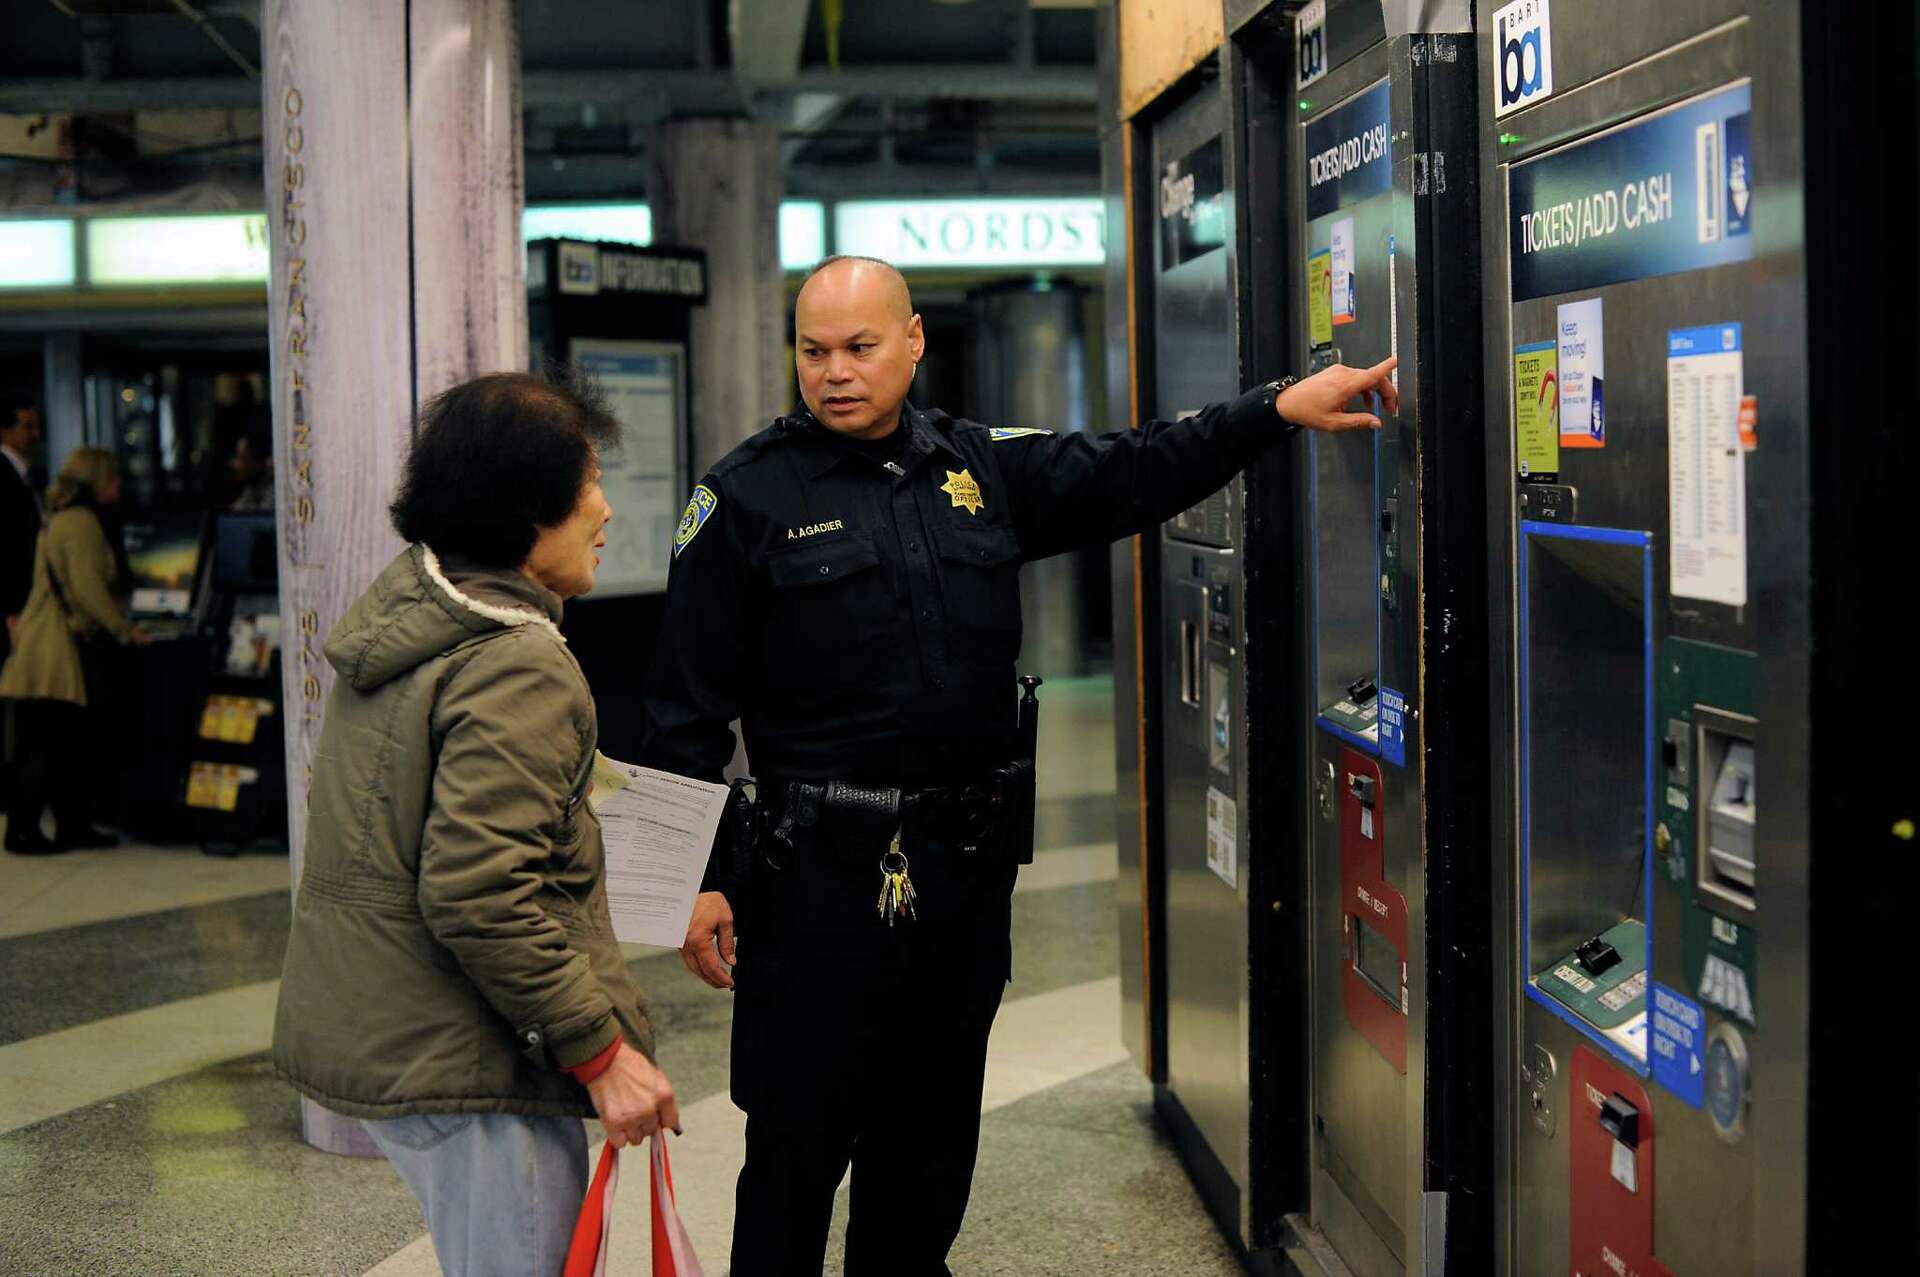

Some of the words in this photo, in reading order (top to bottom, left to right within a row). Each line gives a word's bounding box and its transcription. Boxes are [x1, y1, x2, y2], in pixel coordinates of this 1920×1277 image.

[1509, 0, 1540, 28] BART
[1310, 137, 1361, 187] TICKETS/ADD
[1362, 123, 1387, 163] CASH
[283, 86, 309, 391] FRANCISCO
[1521, 191, 1618, 253] TICKETS/ADD
[1622, 173, 1672, 229] CASH
[291, 423, 315, 524] SAN
[788, 528, 798, 540] A.
[799, 519, 843, 538] AGADIER
